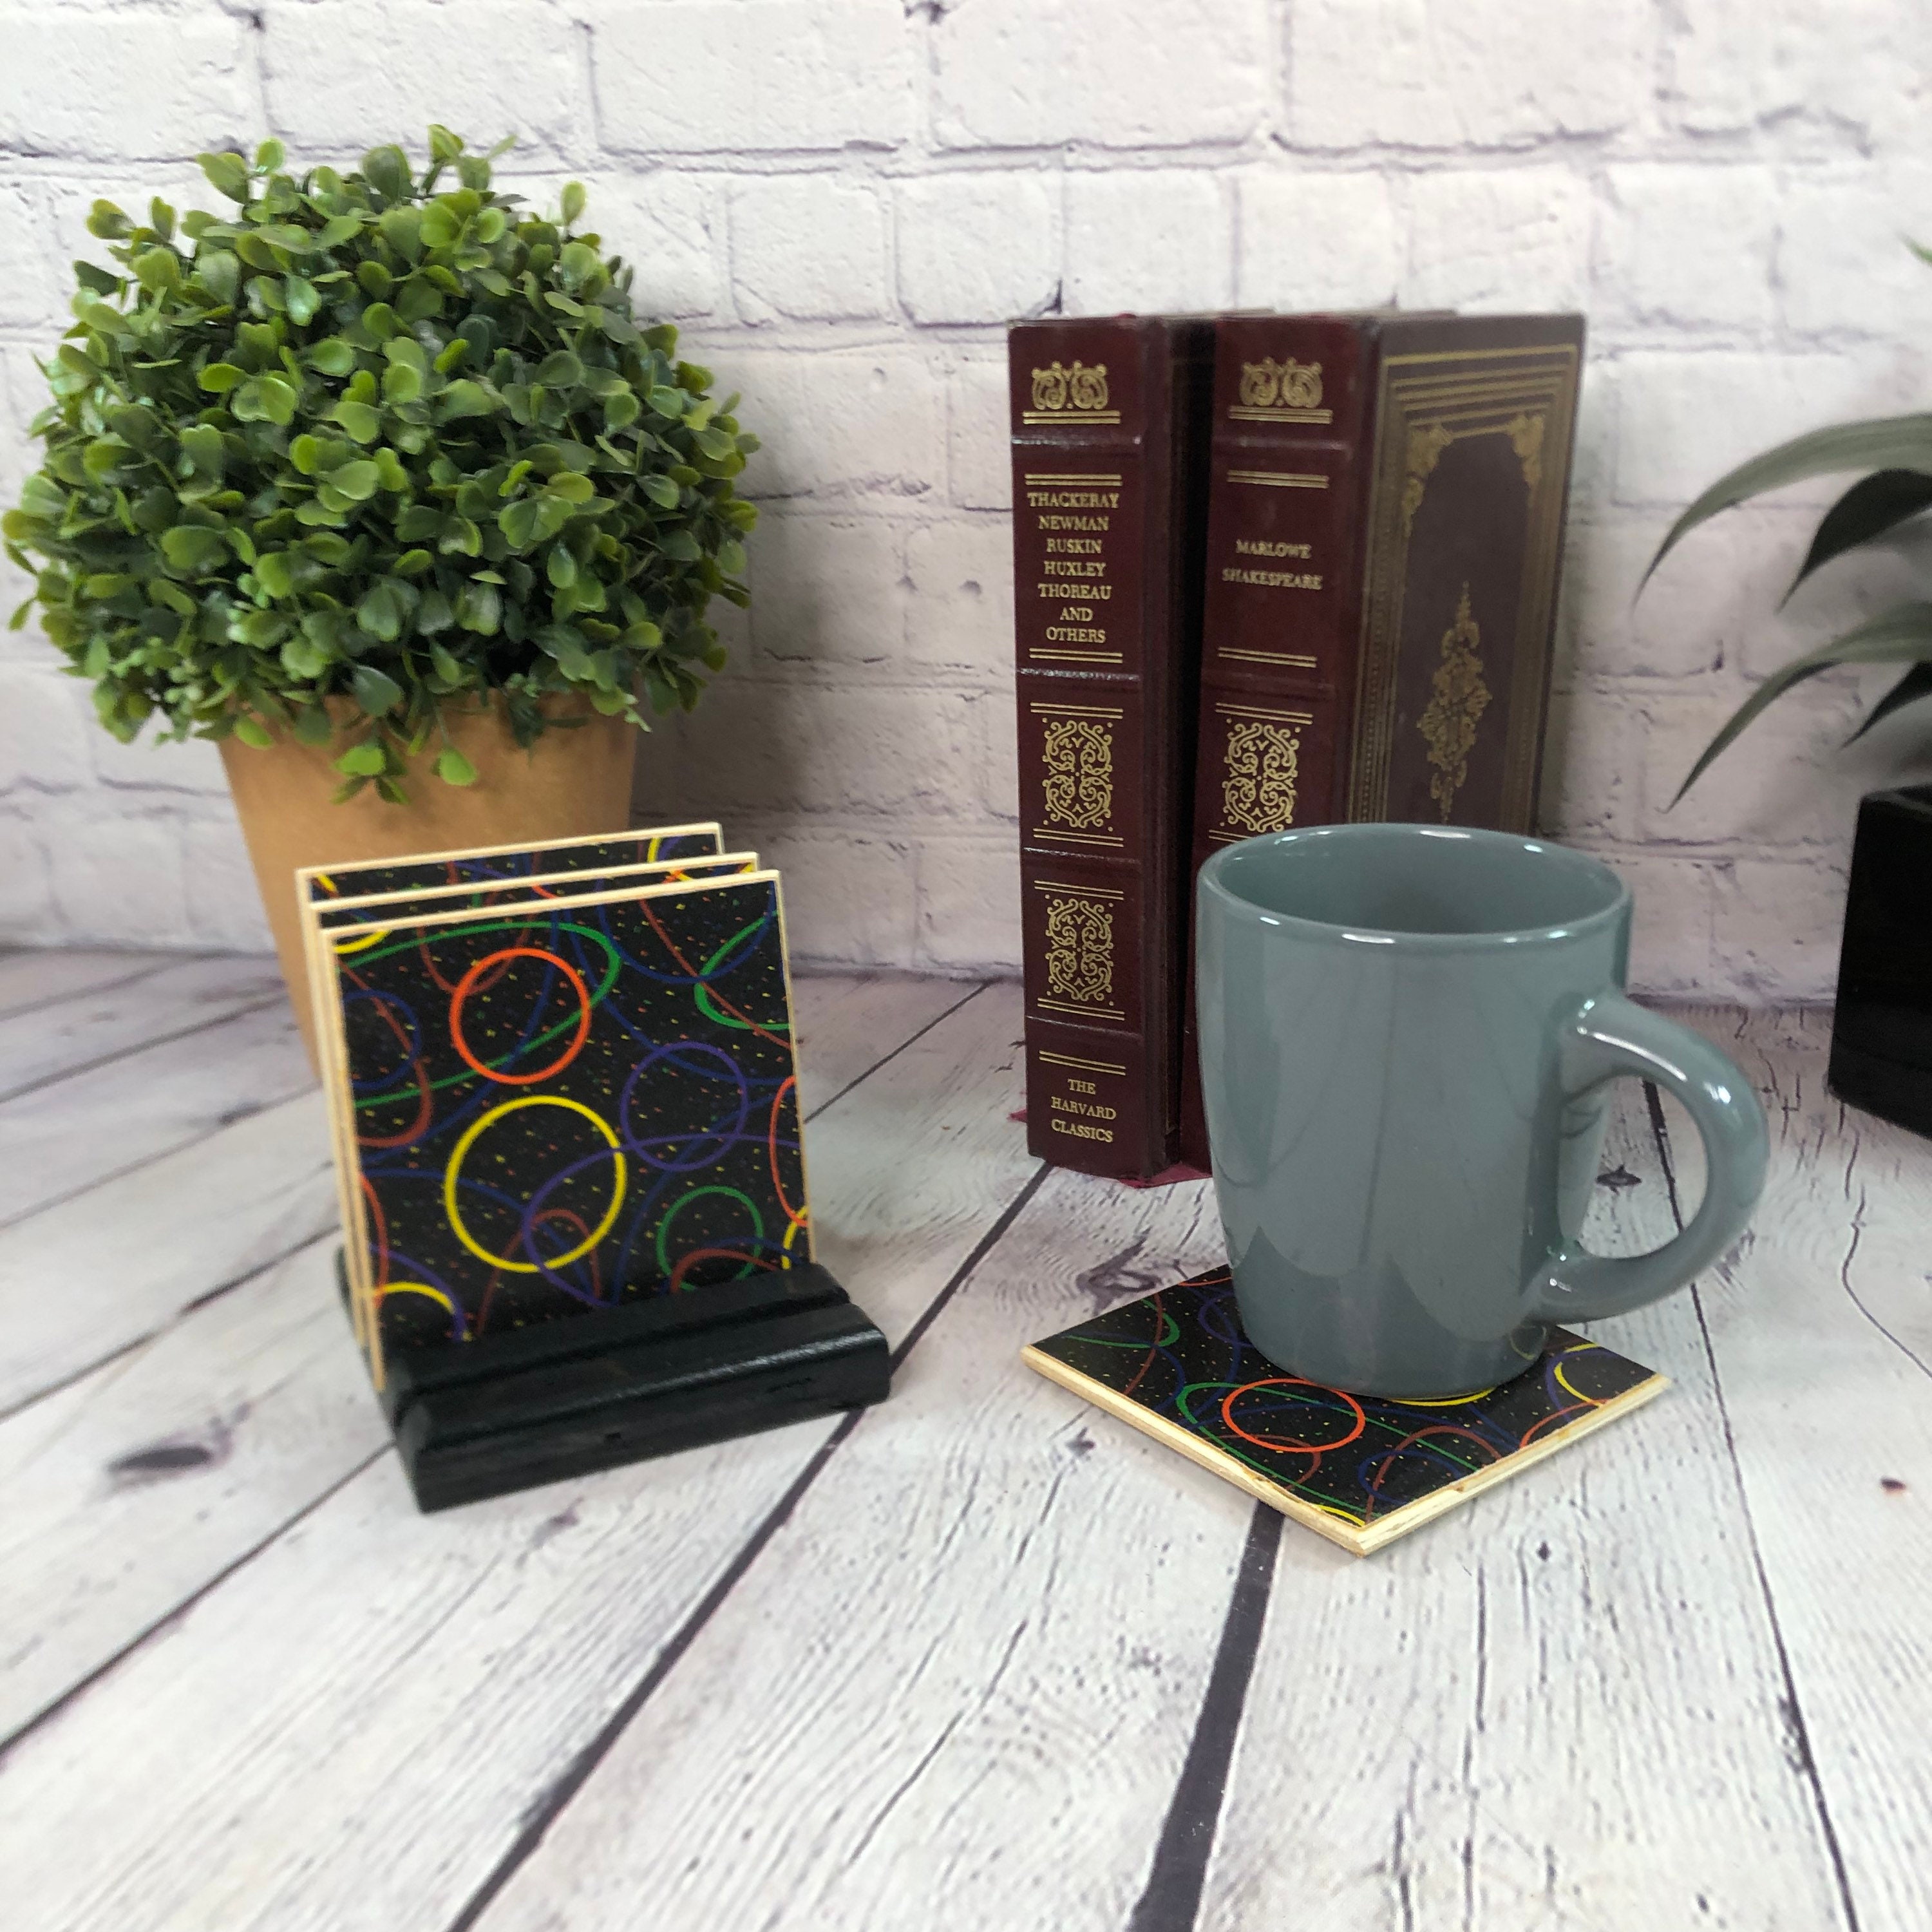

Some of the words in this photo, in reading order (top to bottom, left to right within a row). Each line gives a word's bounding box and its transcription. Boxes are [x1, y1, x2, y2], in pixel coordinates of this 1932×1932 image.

[1027, 492, 1119, 508] THACKERAY
[1038, 515, 1109, 531] NEWMAN
[1046, 538, 1102, 554] RUSKIN
[1235, 538, 1312, 559] MARLOWE
[1043, 561, 1106, 577] HUXLEY
[1222, 567, 1323, 590] SHAKESPEARE
[1037, 583, 1112, 600] THOREAU
[1059, 607, 1094, 621] AND
[1046, 626, 1106, 643] OTHERS
[1067, 1079, 1096, 1095] THE
[1050, 1096, 1117, 1120] HARVARD
[1051, 1119, 1113, 1143] CLASSICS
